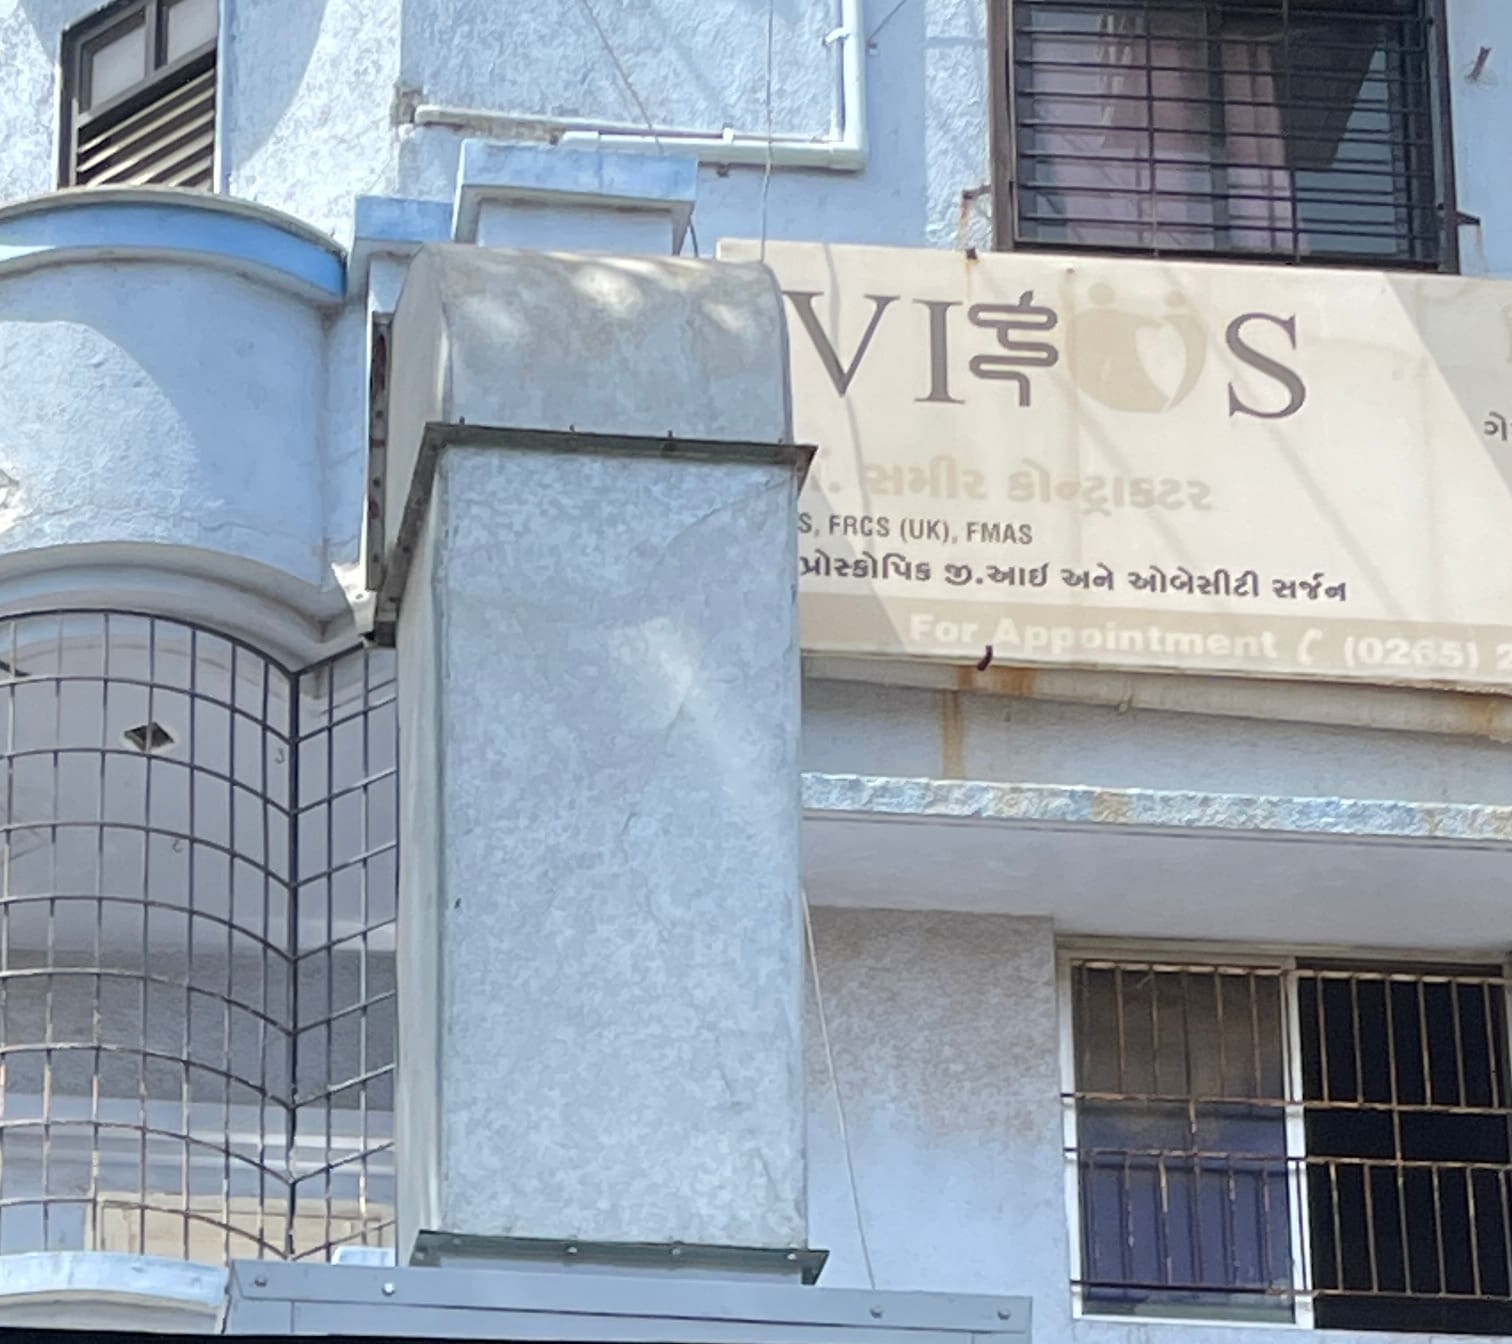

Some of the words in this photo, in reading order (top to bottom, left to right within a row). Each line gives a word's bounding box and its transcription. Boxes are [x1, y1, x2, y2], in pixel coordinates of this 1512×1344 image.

[829, 515, 890, 539] FRCS
[900, 520, 958, 545] (UK),
[966, 522, 1033, 545] FMAS
[1060, 562, 1114, 591] અને
[1126, 565, 1260, 599] ઓબેસીટી
[1272, 573, 1347, 602] સર્જન
[909, 613, 978, 643] For
[993, 617, 1277, 659] Appointment
